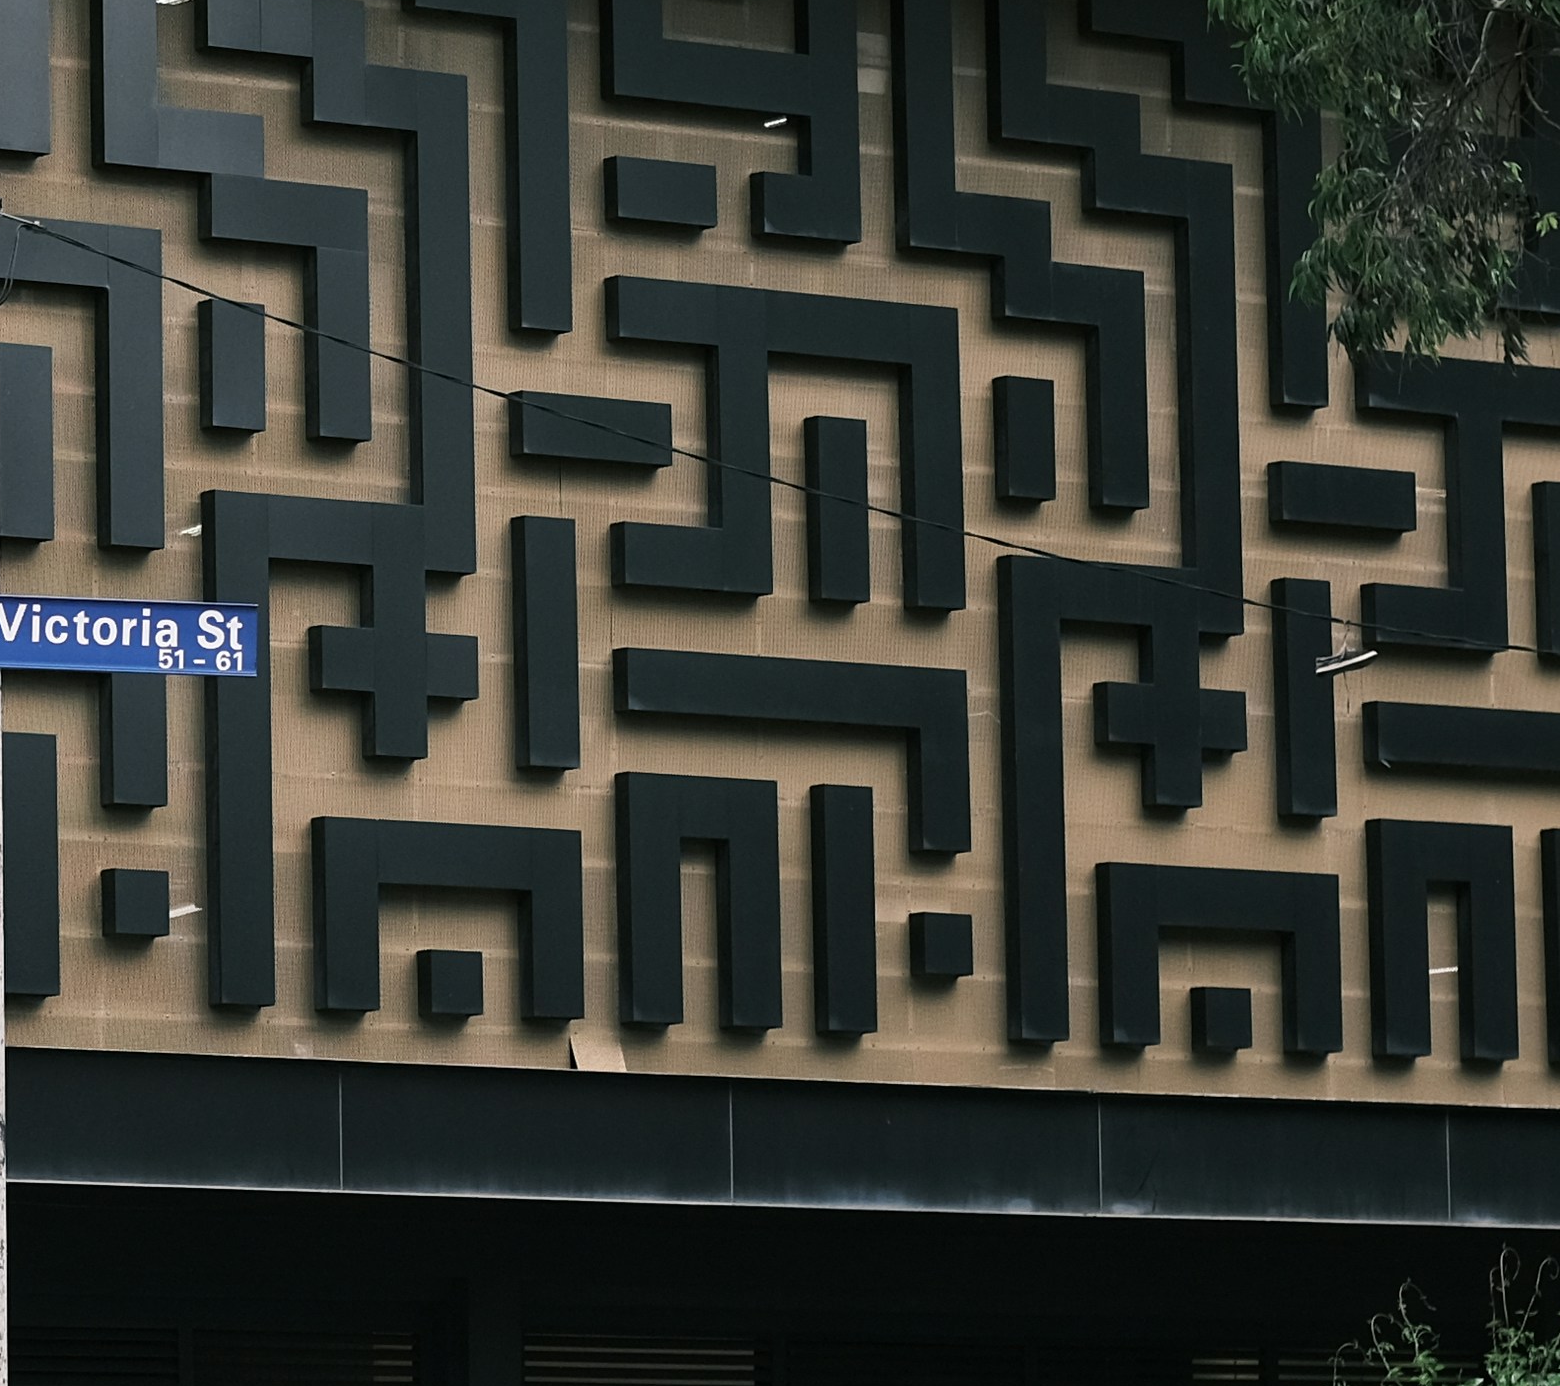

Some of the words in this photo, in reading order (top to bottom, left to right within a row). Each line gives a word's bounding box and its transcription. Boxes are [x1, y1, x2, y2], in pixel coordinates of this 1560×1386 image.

[196, 609, 243, 651] St
[158, 649, 185, 669] 51
[215, 651, 244, 671] 61
